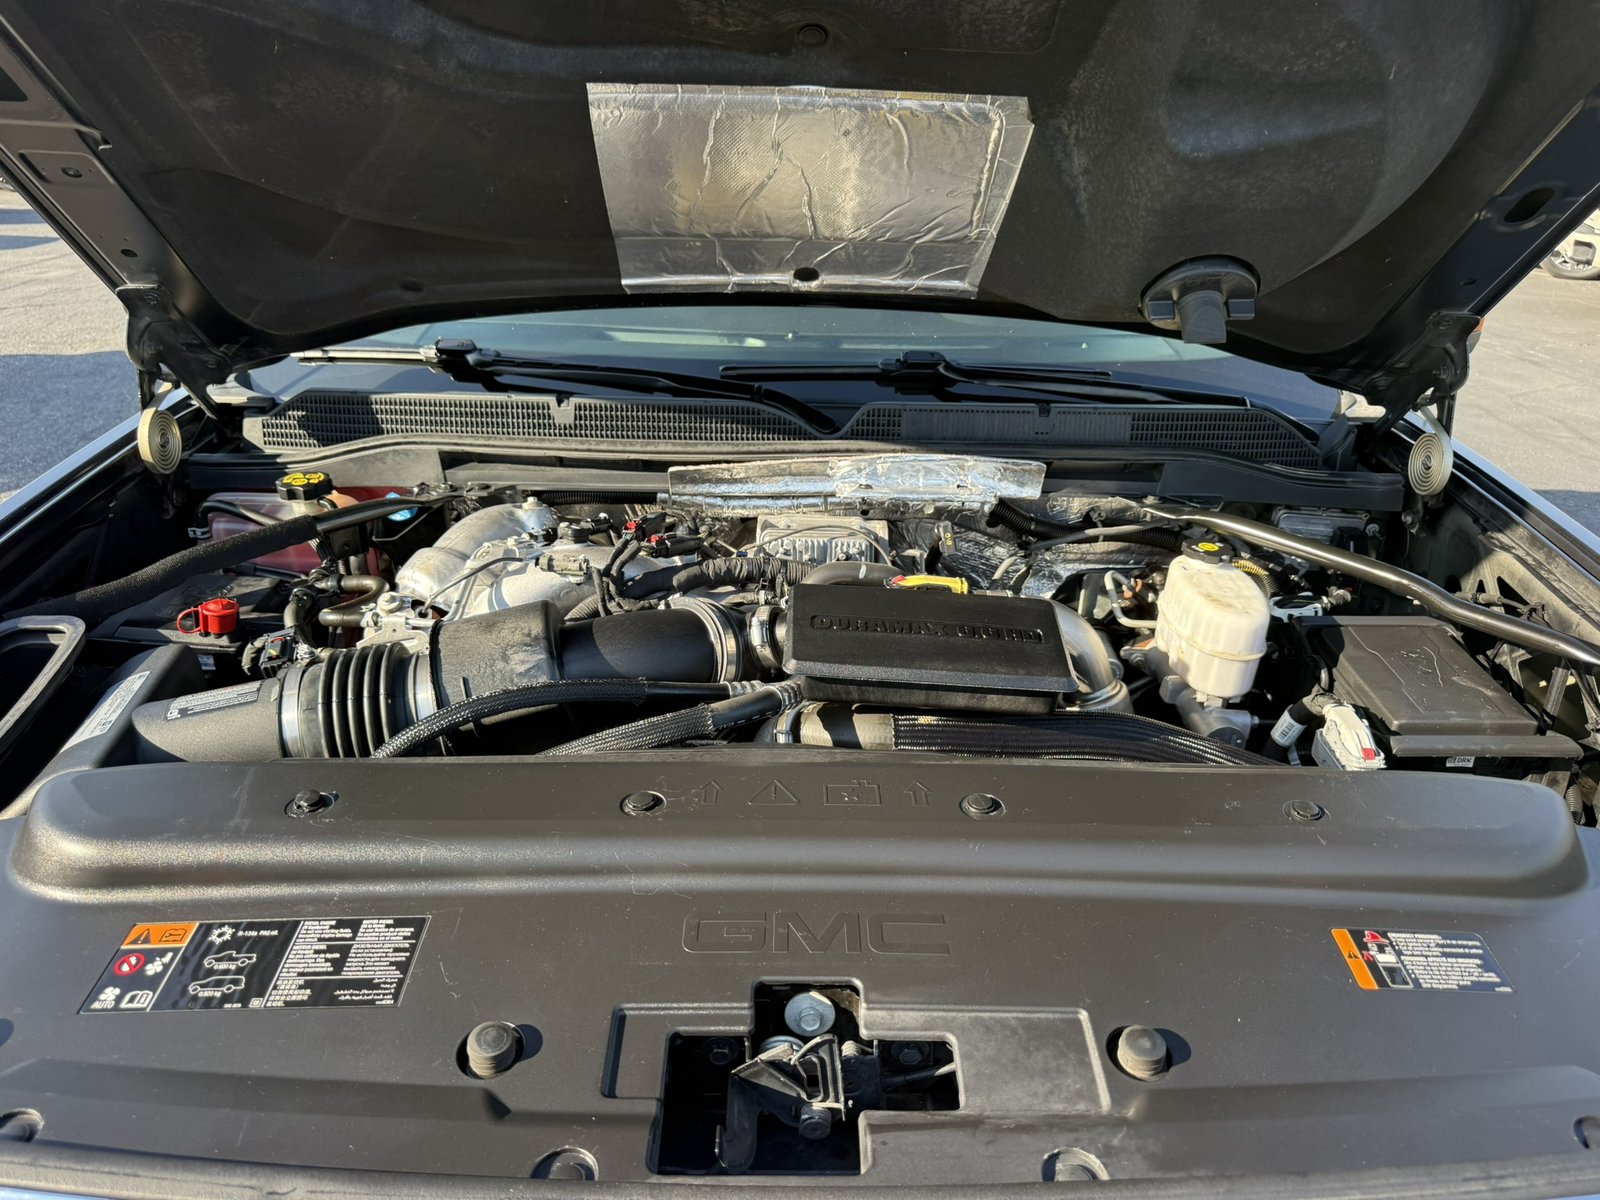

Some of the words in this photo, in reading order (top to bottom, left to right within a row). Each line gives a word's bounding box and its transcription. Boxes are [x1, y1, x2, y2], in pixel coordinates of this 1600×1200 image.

[815, 618, 948, 636] DURAMAX
[1004, 628, 1044, 643] HD
[682, 912, 949, 955] GMC
[90, 1000, 115, 1009] AUTO
